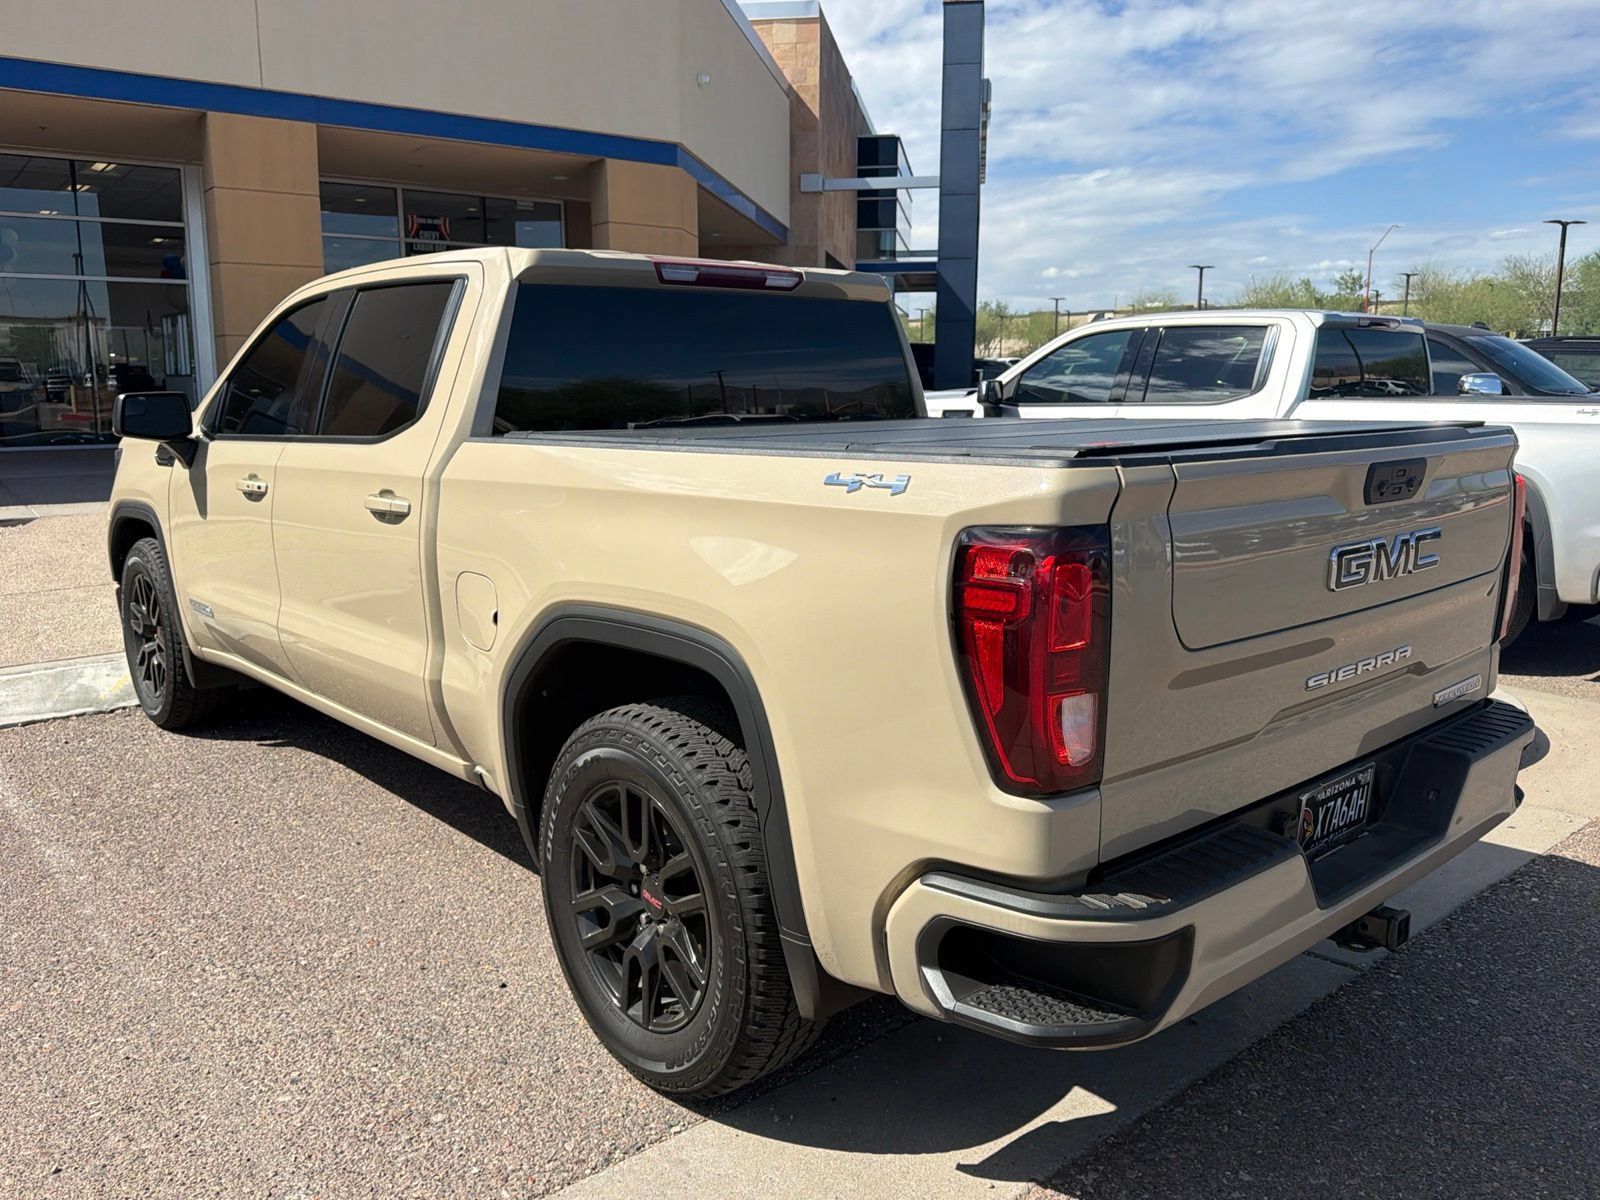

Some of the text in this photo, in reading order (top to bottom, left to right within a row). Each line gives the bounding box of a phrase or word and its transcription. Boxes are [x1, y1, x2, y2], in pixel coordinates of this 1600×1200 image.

[1329, 527, 1442, 591] GMC
[1306, 645, 1412, 690] SIERRA
[1313, 785, 1368, 840] X7A6AH
[1319, 777, 1356, 800] ARIZONA
[642, 889, 662, 909] GMC
[665, 937, 724, 1070] BRIDGESTONE
